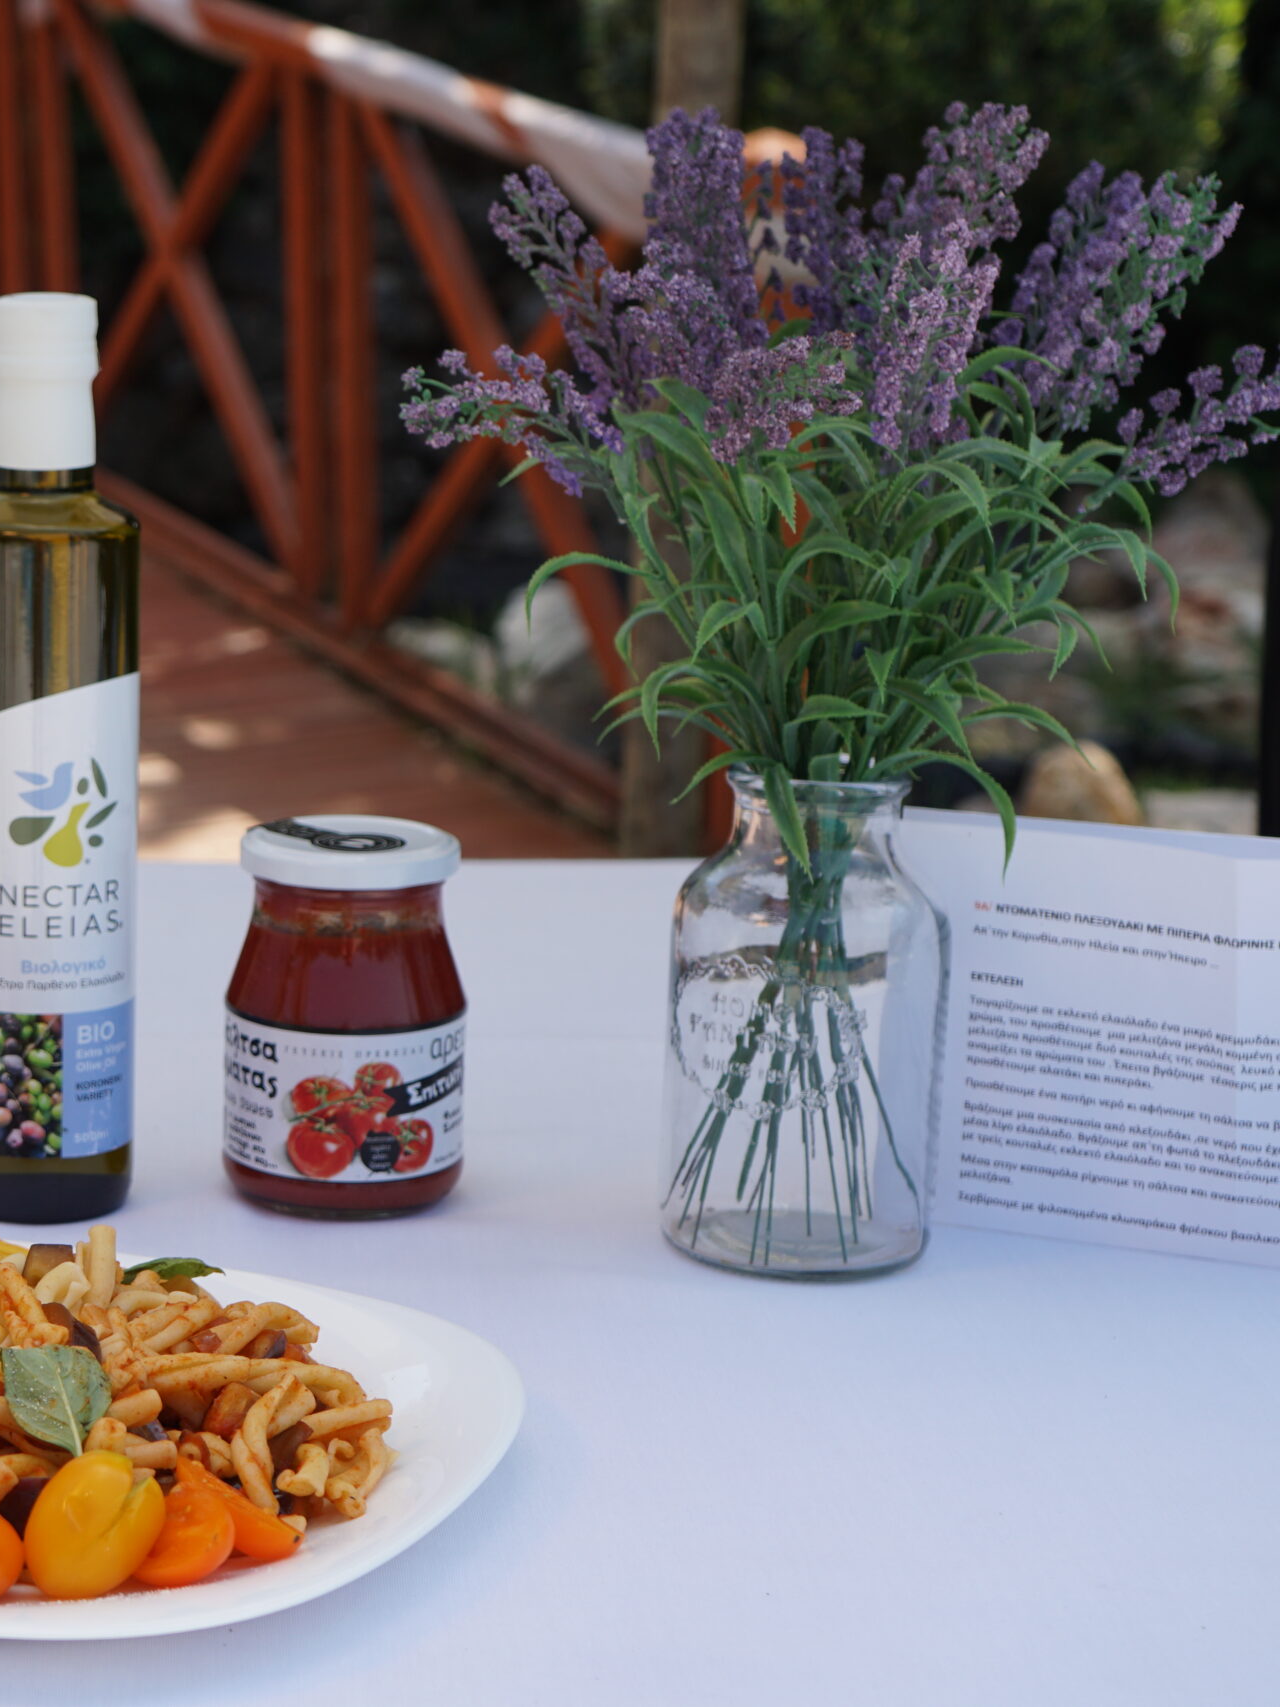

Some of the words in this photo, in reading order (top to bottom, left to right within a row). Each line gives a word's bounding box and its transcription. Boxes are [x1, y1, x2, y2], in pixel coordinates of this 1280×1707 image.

[996, 903, 1071, 922] ΝΤΟΜΑΤΕΝΙΟ
[1074, 913, 1143, 931] ΠΛΕΞΟΥΔΑΚΙ
[1146, 923, 1164, 934] ΜΕ
[1167, 926, 1210, 942] ΠΙΠΕΡΙΑ
[1213, 935, 1275, 949] ΦΛΩΡΙΝΗΣ
[21, 955, 106, 975] Βιολογικό
[970, 971, 1023, 987] ΕΚΤΕΛΕΣΗ
[77, 1020, 115, 1044] BIO
